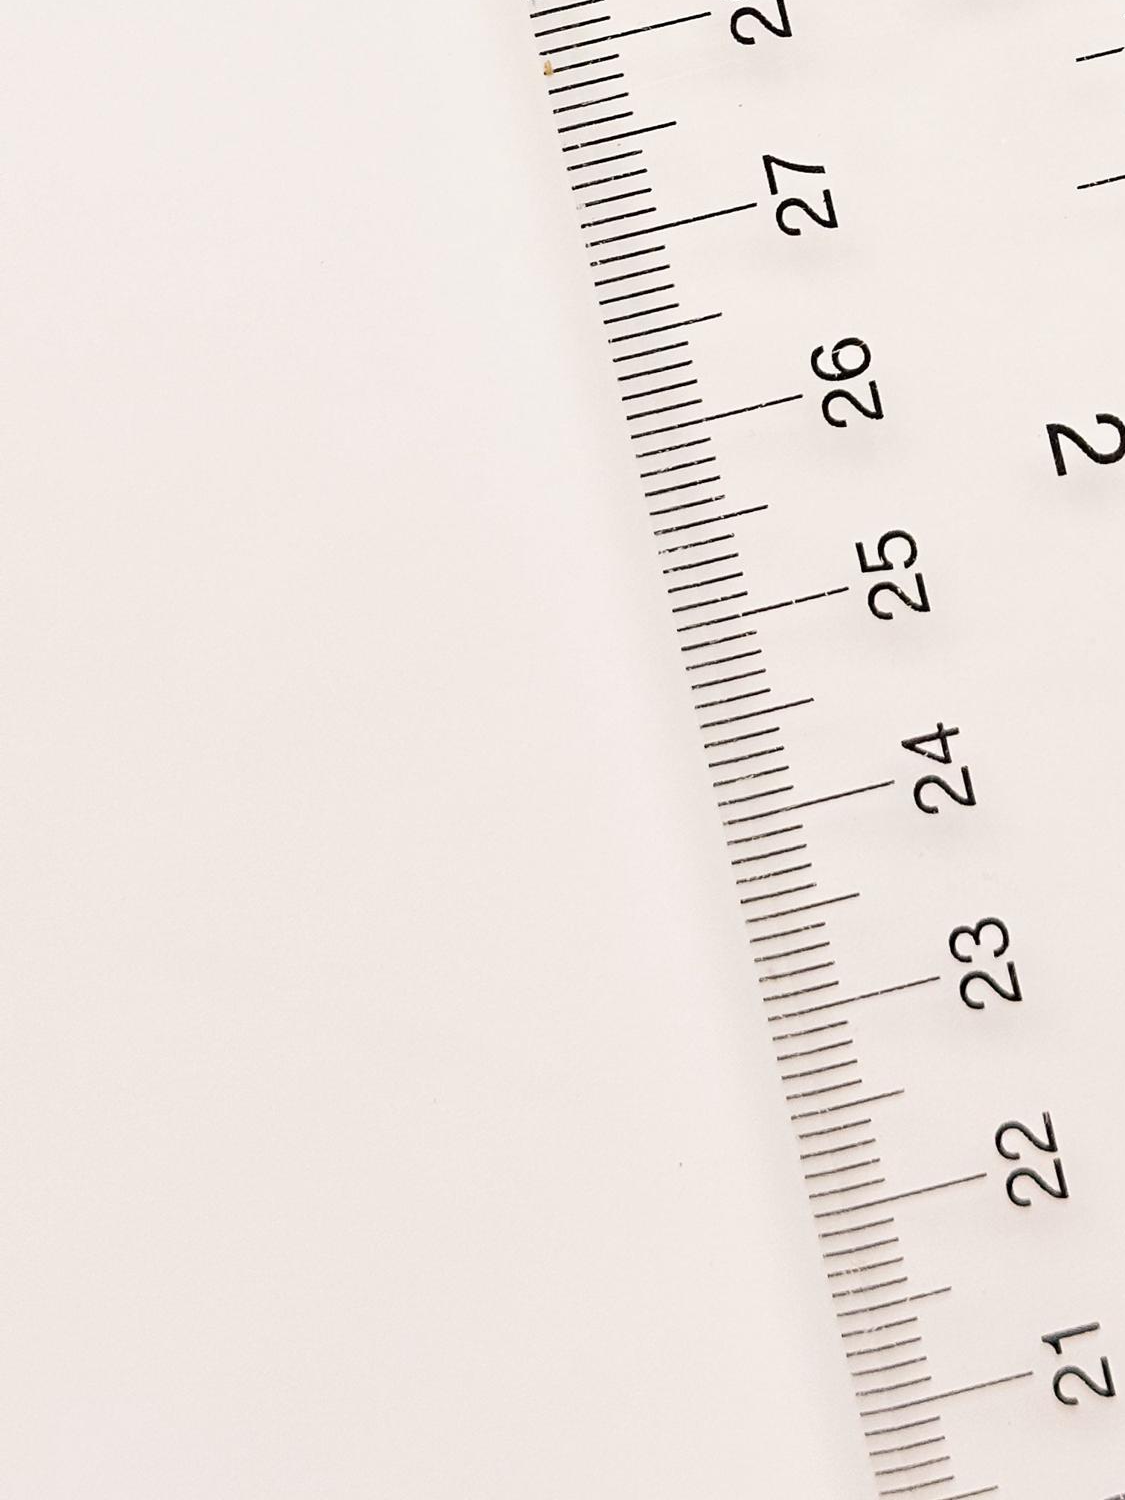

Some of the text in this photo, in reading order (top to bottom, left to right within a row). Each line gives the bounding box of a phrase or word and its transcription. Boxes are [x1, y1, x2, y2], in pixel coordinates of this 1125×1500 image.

[762, 154, 839, 237] 27
[810, 337, 885, 428] 26
[855, 529, 931, 621] 25
[900, 722, 977, 815] 24
[948, 917, 1023, 1011] 23
[994, 1111, 1070, 1208] 22
[1041, 1323, 1116, 1406] 21
